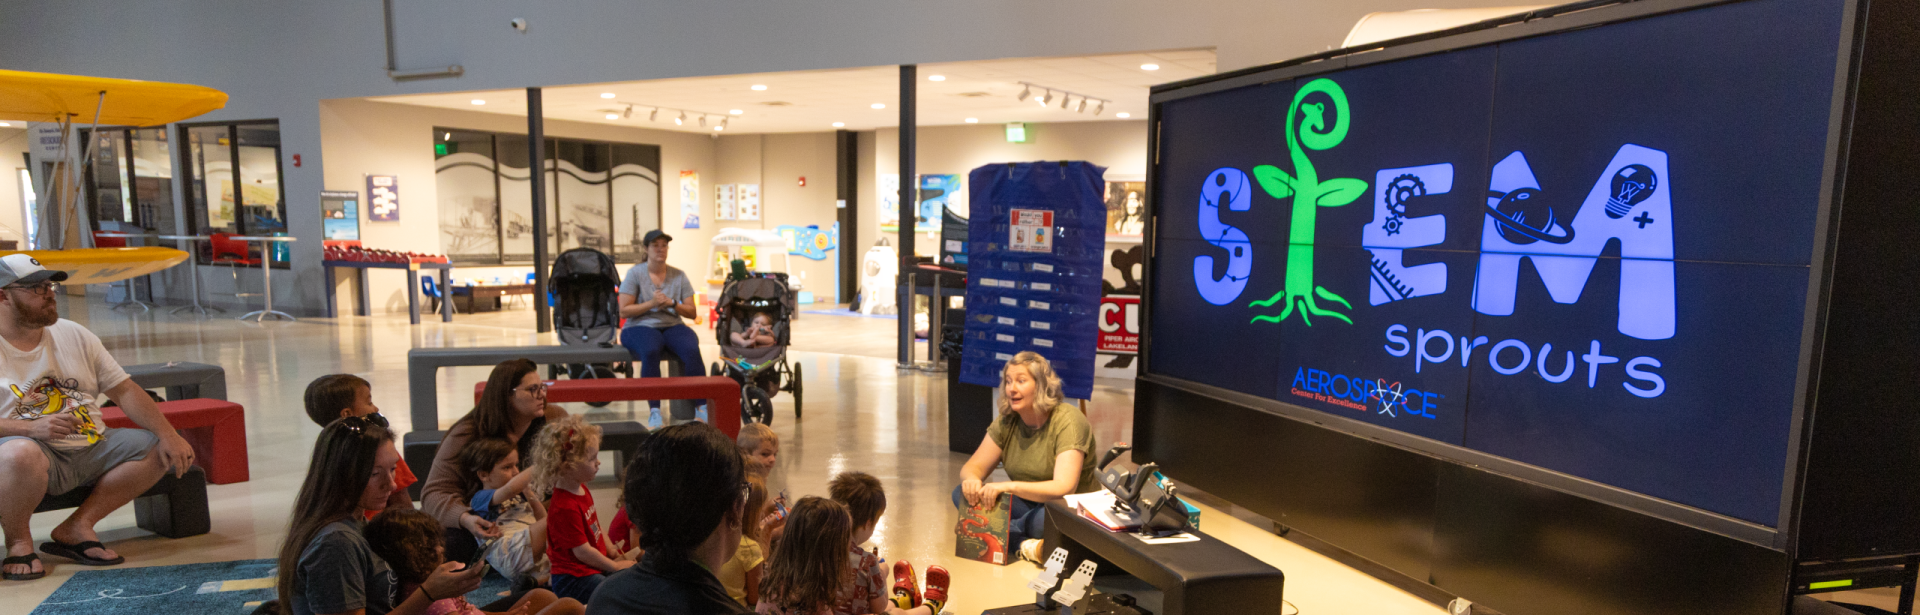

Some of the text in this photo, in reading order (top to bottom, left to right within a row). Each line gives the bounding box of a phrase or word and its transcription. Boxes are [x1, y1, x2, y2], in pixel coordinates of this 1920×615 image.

[1193, 78, 1676, 340] STEM
[1292, 366, 1437, 419] AEROSPACE
[1384, 323, 1667, 399] sprouts
[1291, 387, 1367, 411] Center For Excellence
